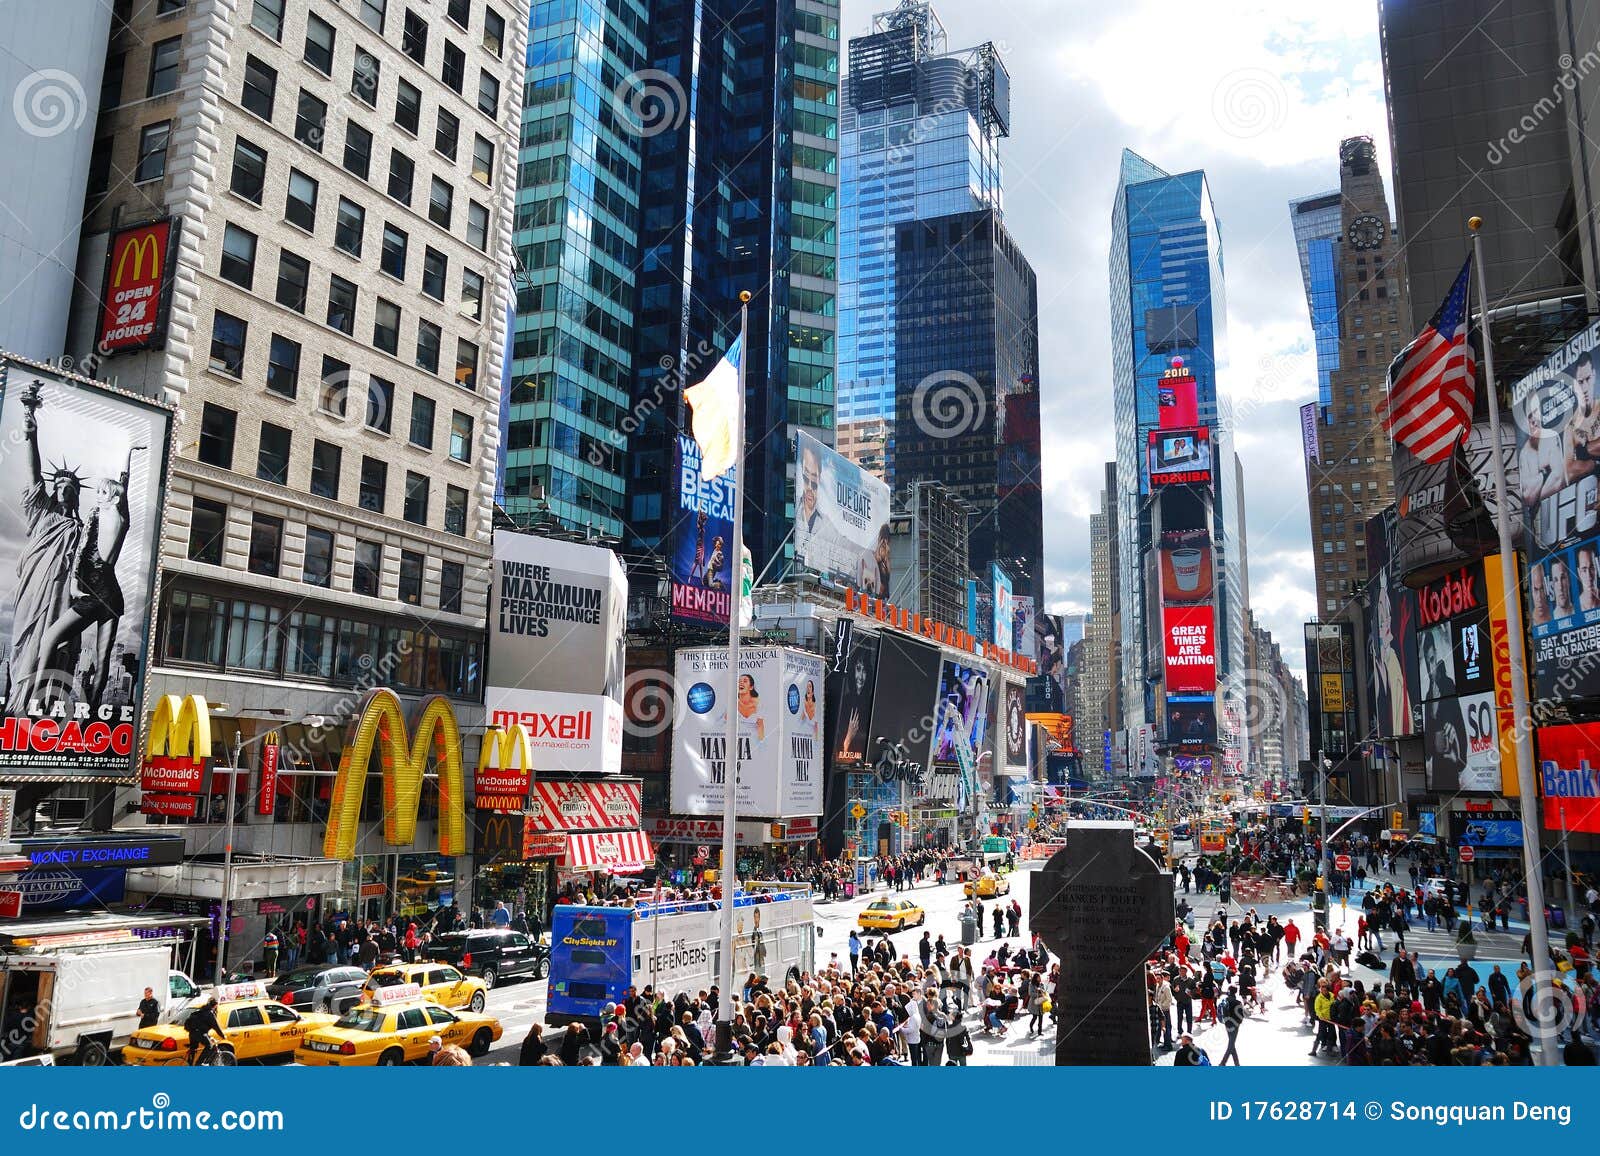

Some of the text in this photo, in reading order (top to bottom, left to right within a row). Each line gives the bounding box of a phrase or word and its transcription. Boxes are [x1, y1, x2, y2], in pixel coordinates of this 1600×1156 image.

[115, 285, 154, 303] OPEN
[116, 300, 147, 325] 24
[105, 322, 154, 342] HOURS
[1548, 323, 1600, 378] VELASQUE
[1164, 368, 1189, 378] 2010
[1159, 377, 1195, 385] TOSHIBA
[1152, 472, 1210, 485] TOSHIBA
[681, 468, 736, 508] BEST
[837, 481, 853, 509] DUE
[854, 489, 872, 520] DATE
[680, 493, 735, 522] MUSICAL
[1541, 474, 1598, 549] UFC
[502, 560, 551, 581] WHERE
[501, 576, 602, 610] MAXIMUM
[672, 583, 731, 616] MEMPHI
[1418, 566, 1477, 625] Kodak
[500, 598, 600, 625] PERFORMANCE
[499, 613, 549, 638] LIVES
[1171, 626, 1207, 636] GREAT
[1172, 635, 1207, 646] TIMES
[1540, 624, 1600, 651] SAT. OCTOBE
[745, 650, 780, 660] MUSICAL
[1178, 645, 1202, 656] ARE
[1536, 638, 1600, 663] LIVE ON PAY-PE
[1167, 655, 1214, 666] WAITING
[1325, 688, 1340, 697] LION
[1325, 698, 1341, 706] KING
[28, 699, 134, 722] LARGE
[492, 710, 592, 740] maxell
[143, 767, 200, 780] McDonald's
[1542, 759, 1596, 799] Bank
[151, 779, 189, 788] Restaurant
[477, 776, 527, 786] McDonald's
[484, 785, 518, 793] Restaurant
[142, 800, 192, 810] OPEN 24 HOURS
[562, 803, 587, 812] FRIDAY'S
[606, 803, 628, 812] FRIDAY'S
[656, 820, 724, 832] DIGITA
[31, 848, 149, 865] MONEY EXCHANGE
[30, 880, 83, 892] EXCHANGE
[1111, 894, 1145, 904] DUFFY
[563, 936, 618, 946] CitySights NY
[672, 938, 685, 950] THE
[649, 947, 707, 973] DEFENDERS
